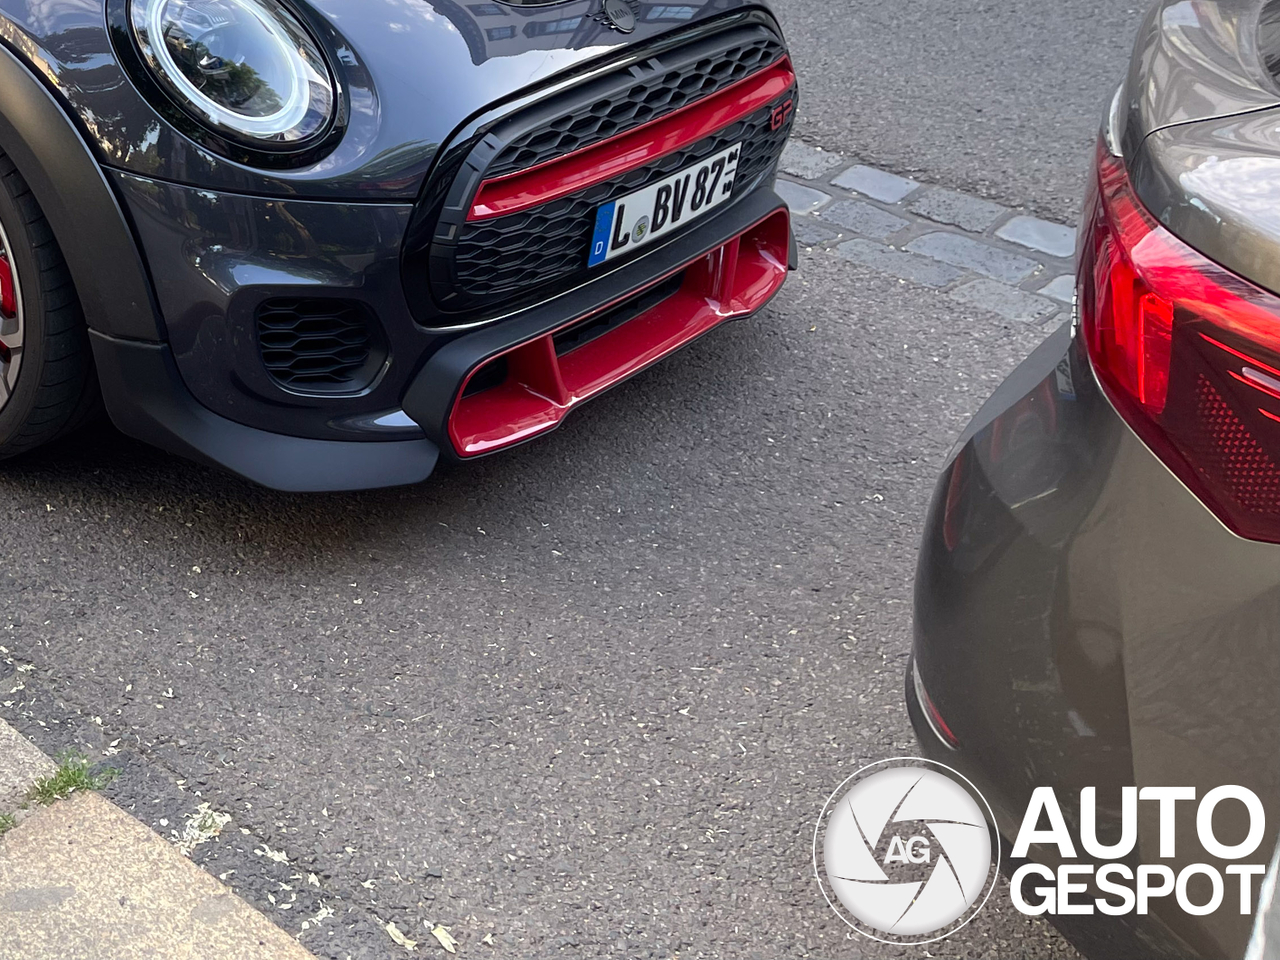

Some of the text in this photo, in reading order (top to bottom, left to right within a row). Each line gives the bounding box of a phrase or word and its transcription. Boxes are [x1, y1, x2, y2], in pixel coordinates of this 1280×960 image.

[771, 99, 793, 131] GP
[610, 156, 727, 251] L BV 87
[594, 241, 604, 255] D
